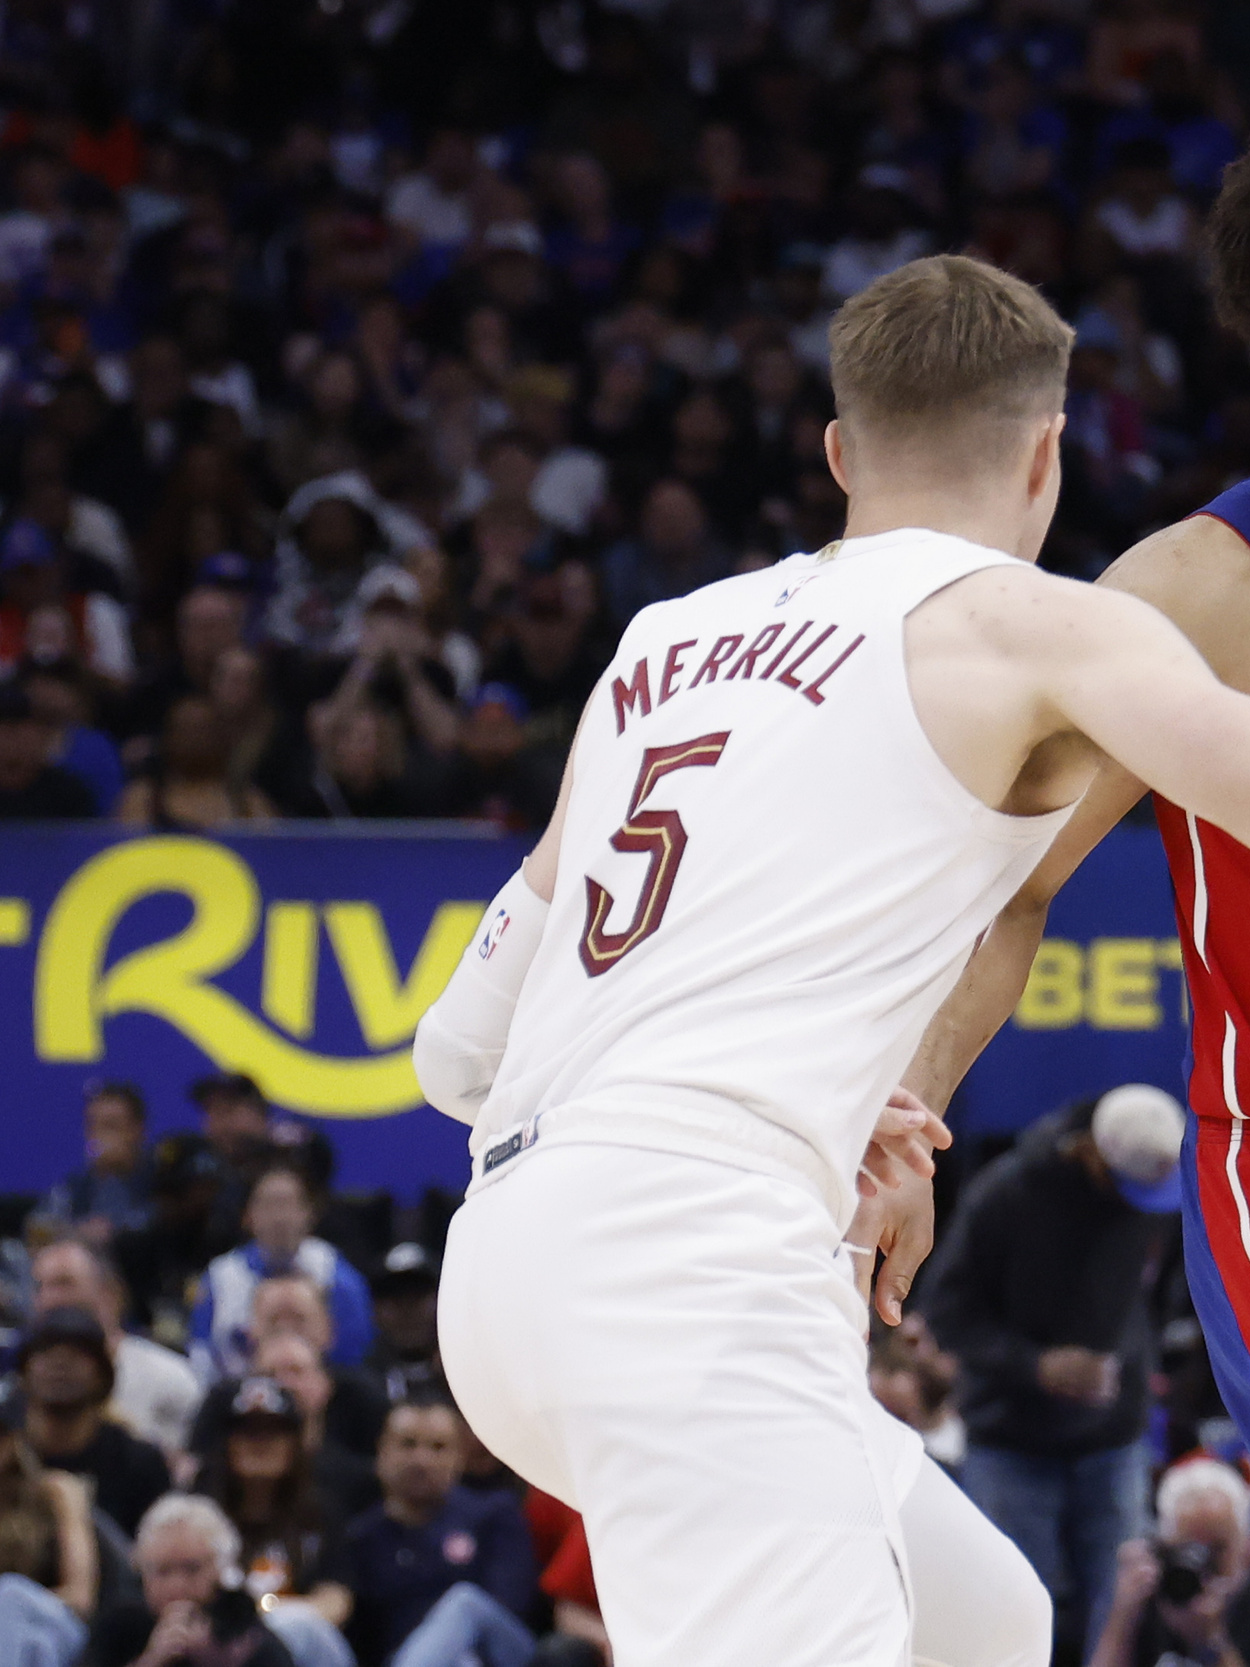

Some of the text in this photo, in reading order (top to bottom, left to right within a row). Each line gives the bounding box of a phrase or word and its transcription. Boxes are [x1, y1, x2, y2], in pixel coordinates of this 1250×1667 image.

[610, 620, 866, 737] MERRILL
[0, 834, 487, 1119] RIV
[578, 730, 733, 979] 5
